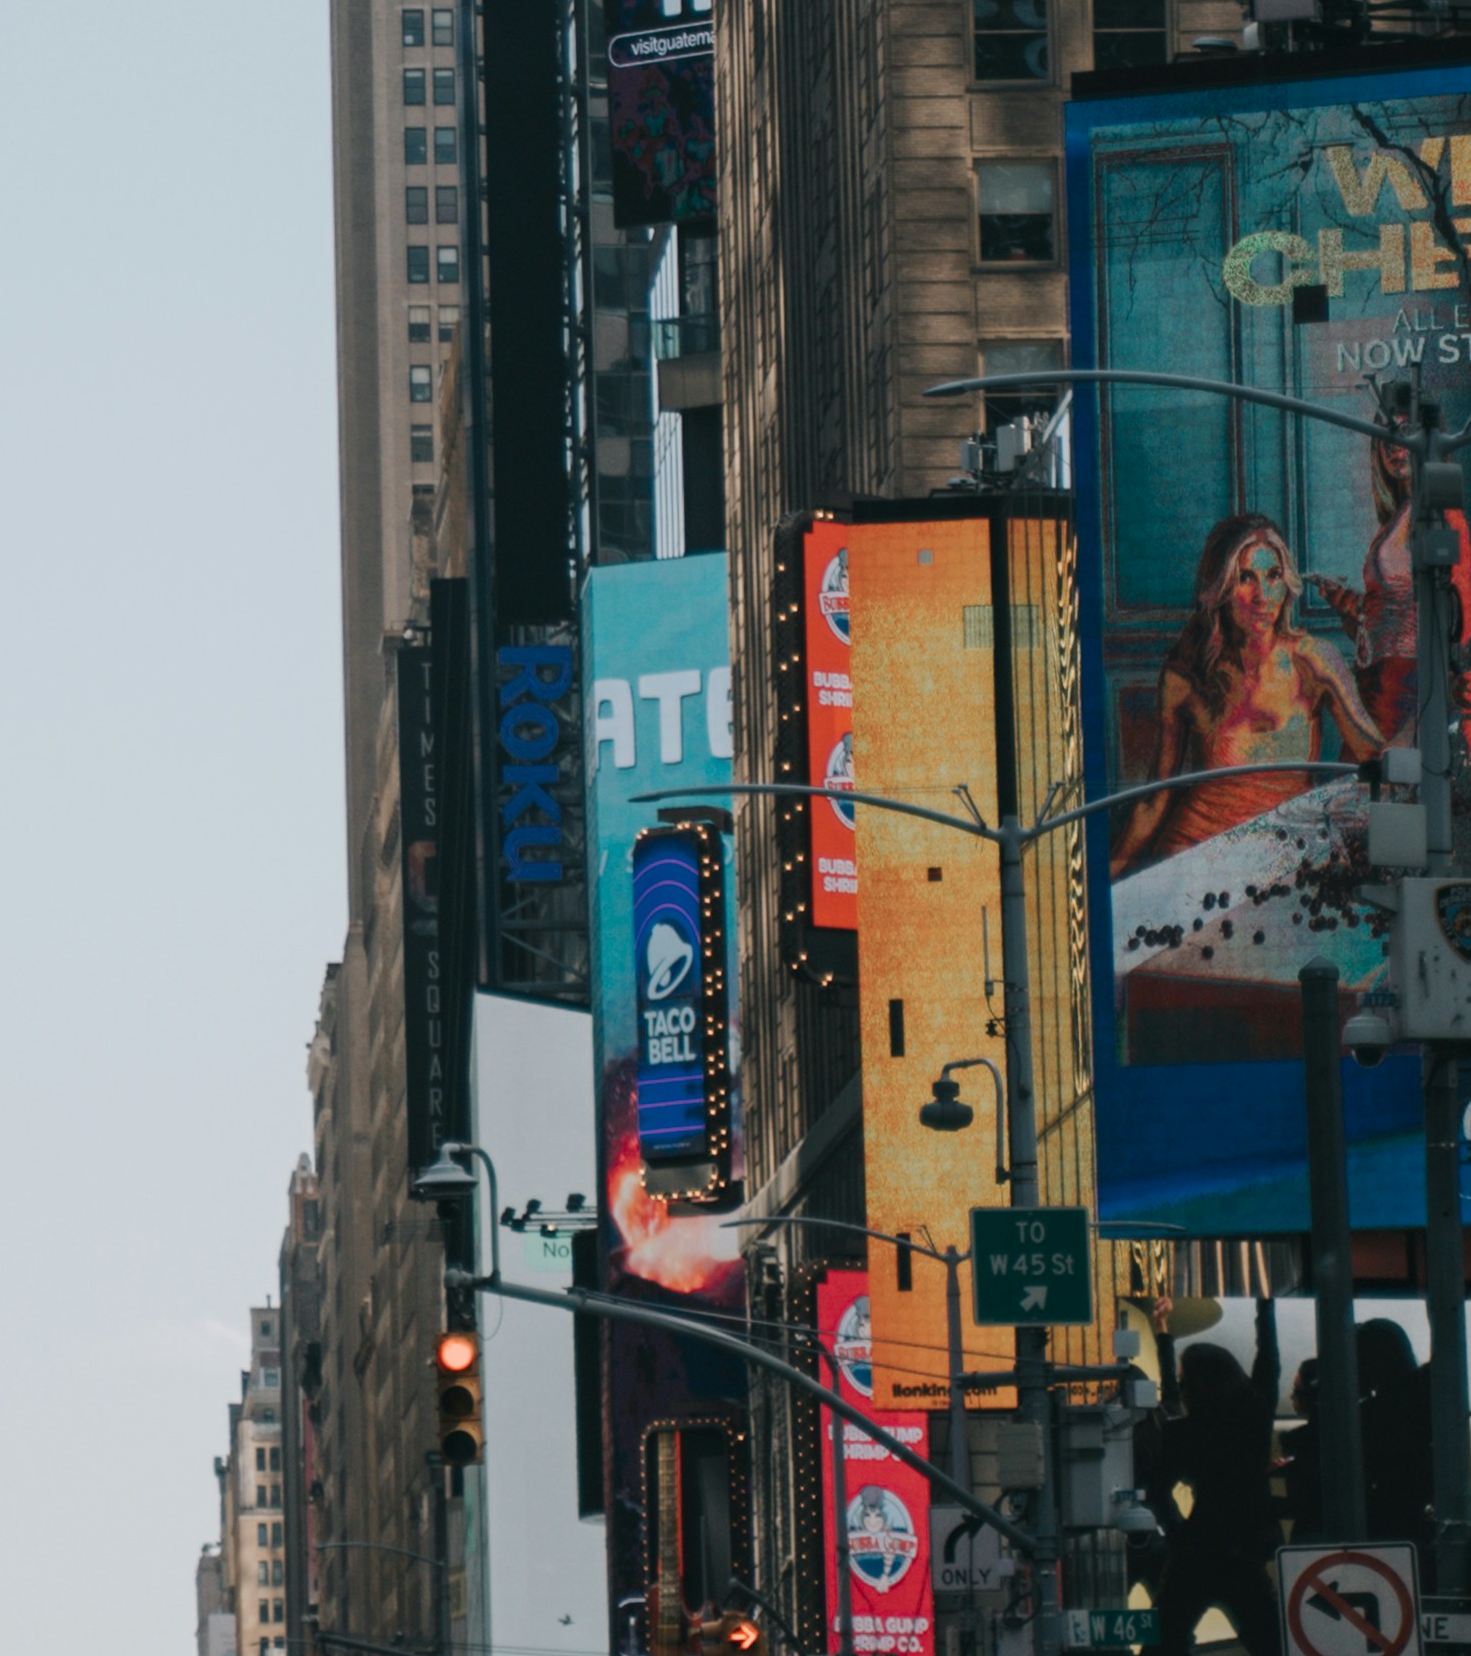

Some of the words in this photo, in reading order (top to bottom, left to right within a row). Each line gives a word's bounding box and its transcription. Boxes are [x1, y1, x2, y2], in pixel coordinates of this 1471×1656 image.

[1392, 307, 1445, 334] ALL
[1336, 335, 1426, 372] NOW
[419, 662, 438, 828] TIMES
[643, 1006, 697, 1038] TACO
[426, 950, 443, 1152] SQUARE
[647, 1032, 698, 1066] BELL
[1014, 1220, 1046, 1244] TO
[989, 1254, 1007, 1276] W
[1011, 1253, 1047, 1277] 45
[1050, 1252, 1075, 1277] St
[941, 1569, 992, 1585] ONLY
[885, 1616, 930, 1635] GUMP
[1091, 1616, 1106, 1640] W
[1112, 1616, 1137, 1640] 46
[1140, 1613, 1155, 1629] St
